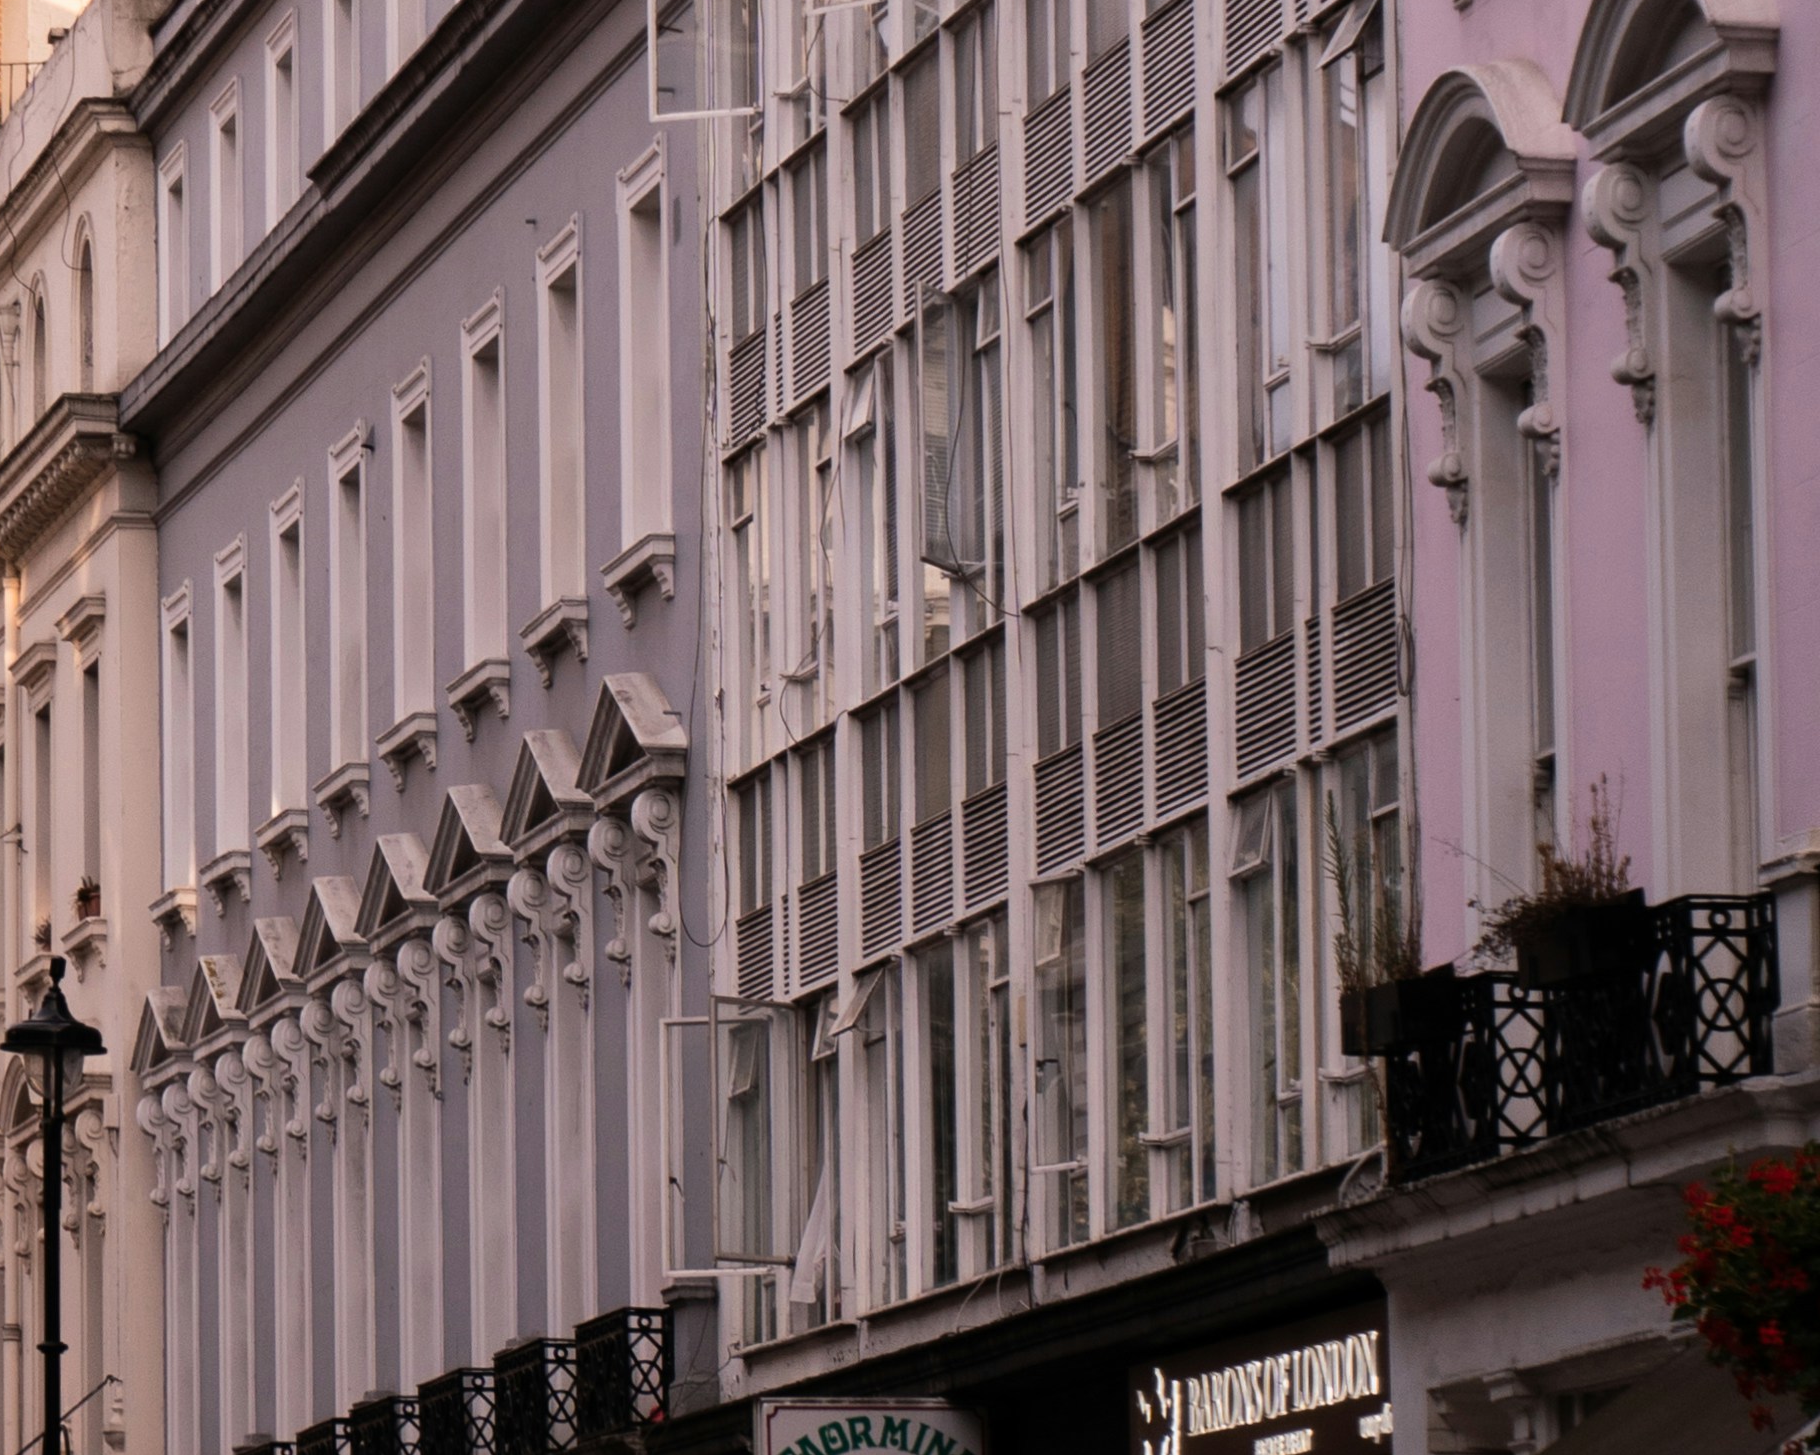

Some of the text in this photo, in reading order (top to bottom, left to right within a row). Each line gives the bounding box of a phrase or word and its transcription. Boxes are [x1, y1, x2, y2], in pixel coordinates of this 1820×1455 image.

[1186, 1330, 1379, 1437] BARONS OF LONDON
